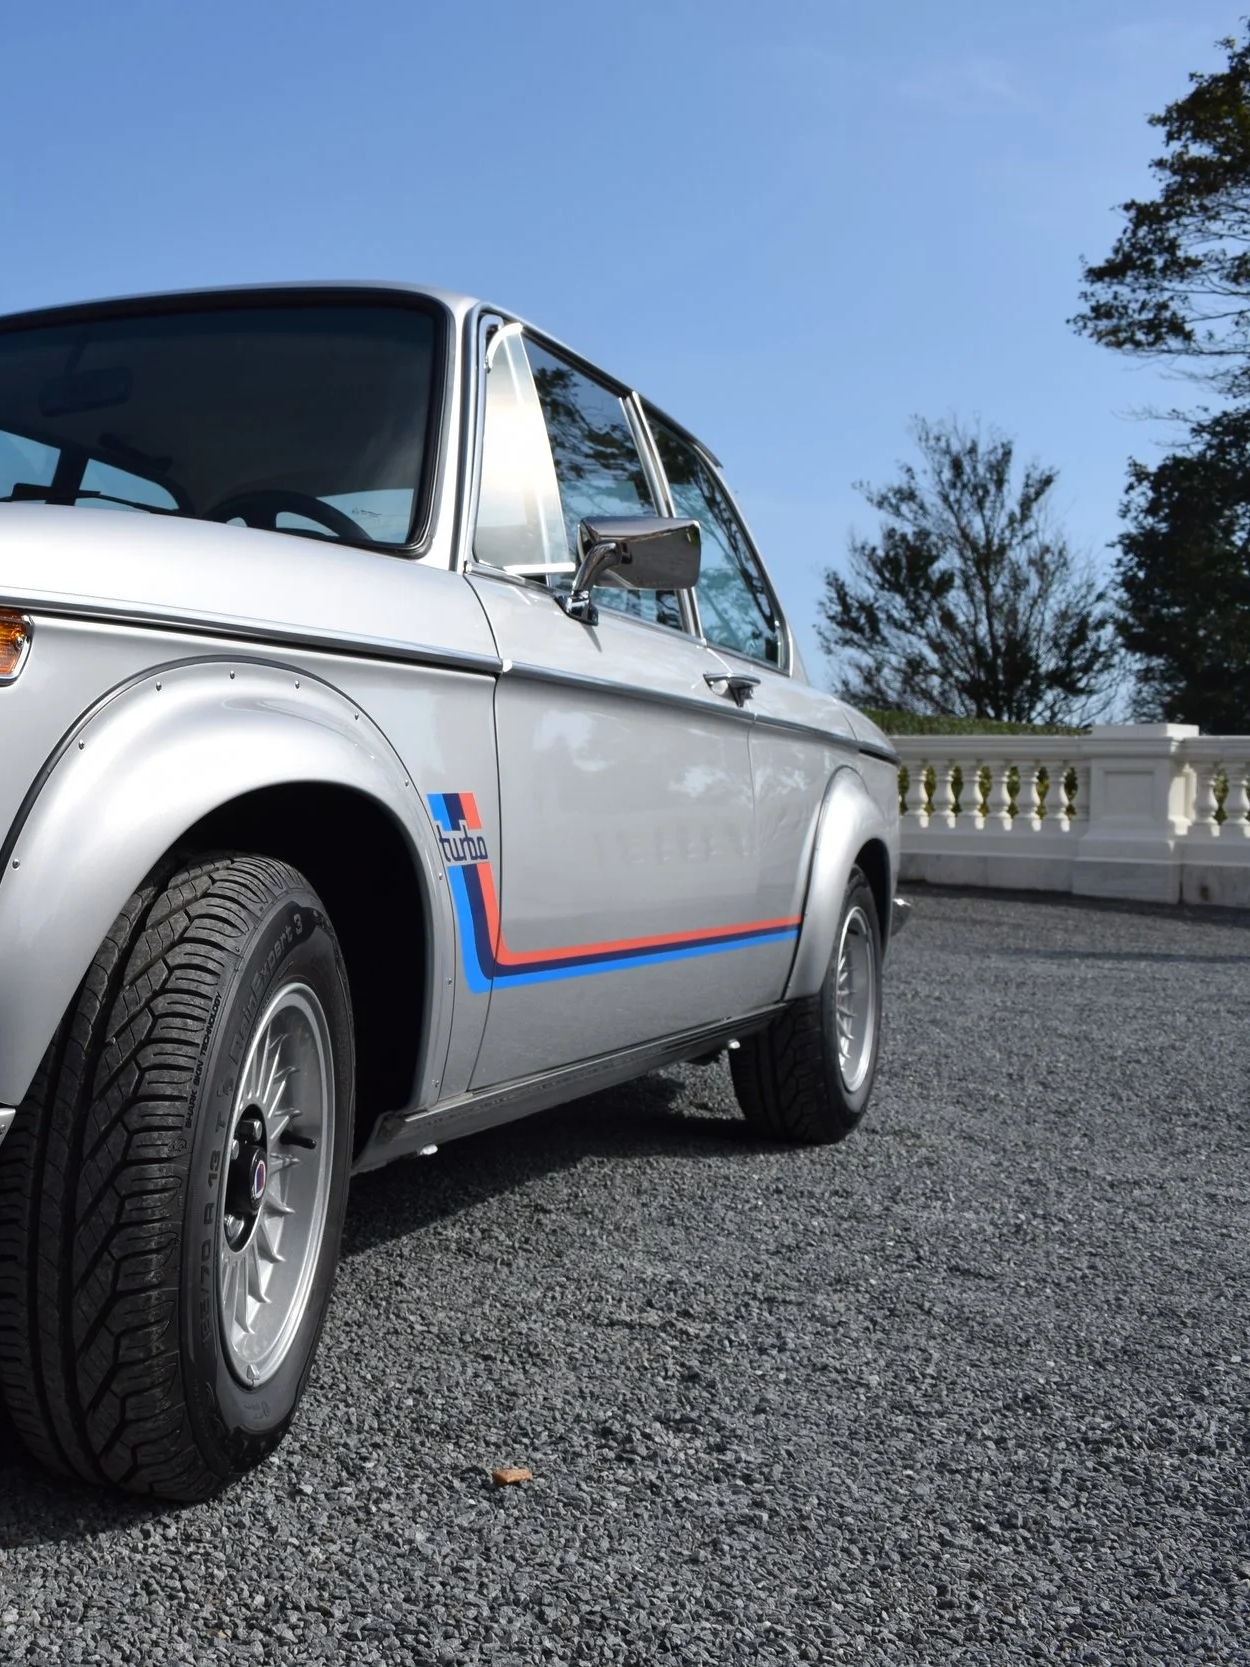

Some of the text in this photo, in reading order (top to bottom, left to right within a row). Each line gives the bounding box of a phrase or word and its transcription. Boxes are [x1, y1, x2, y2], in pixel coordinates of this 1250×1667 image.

[436, 824, 488, 862] turbo
[229, 925, 293, 1066] RainExpert
[293, 913, 303, 935] 3
[184, 991, 222, 1129] SHARK SKIN TECHNOLOGY
[215, 1111, 226, 1133] T
[207, 1150, 220, 1188] 13
[203, 1202, 214, 1225] R
